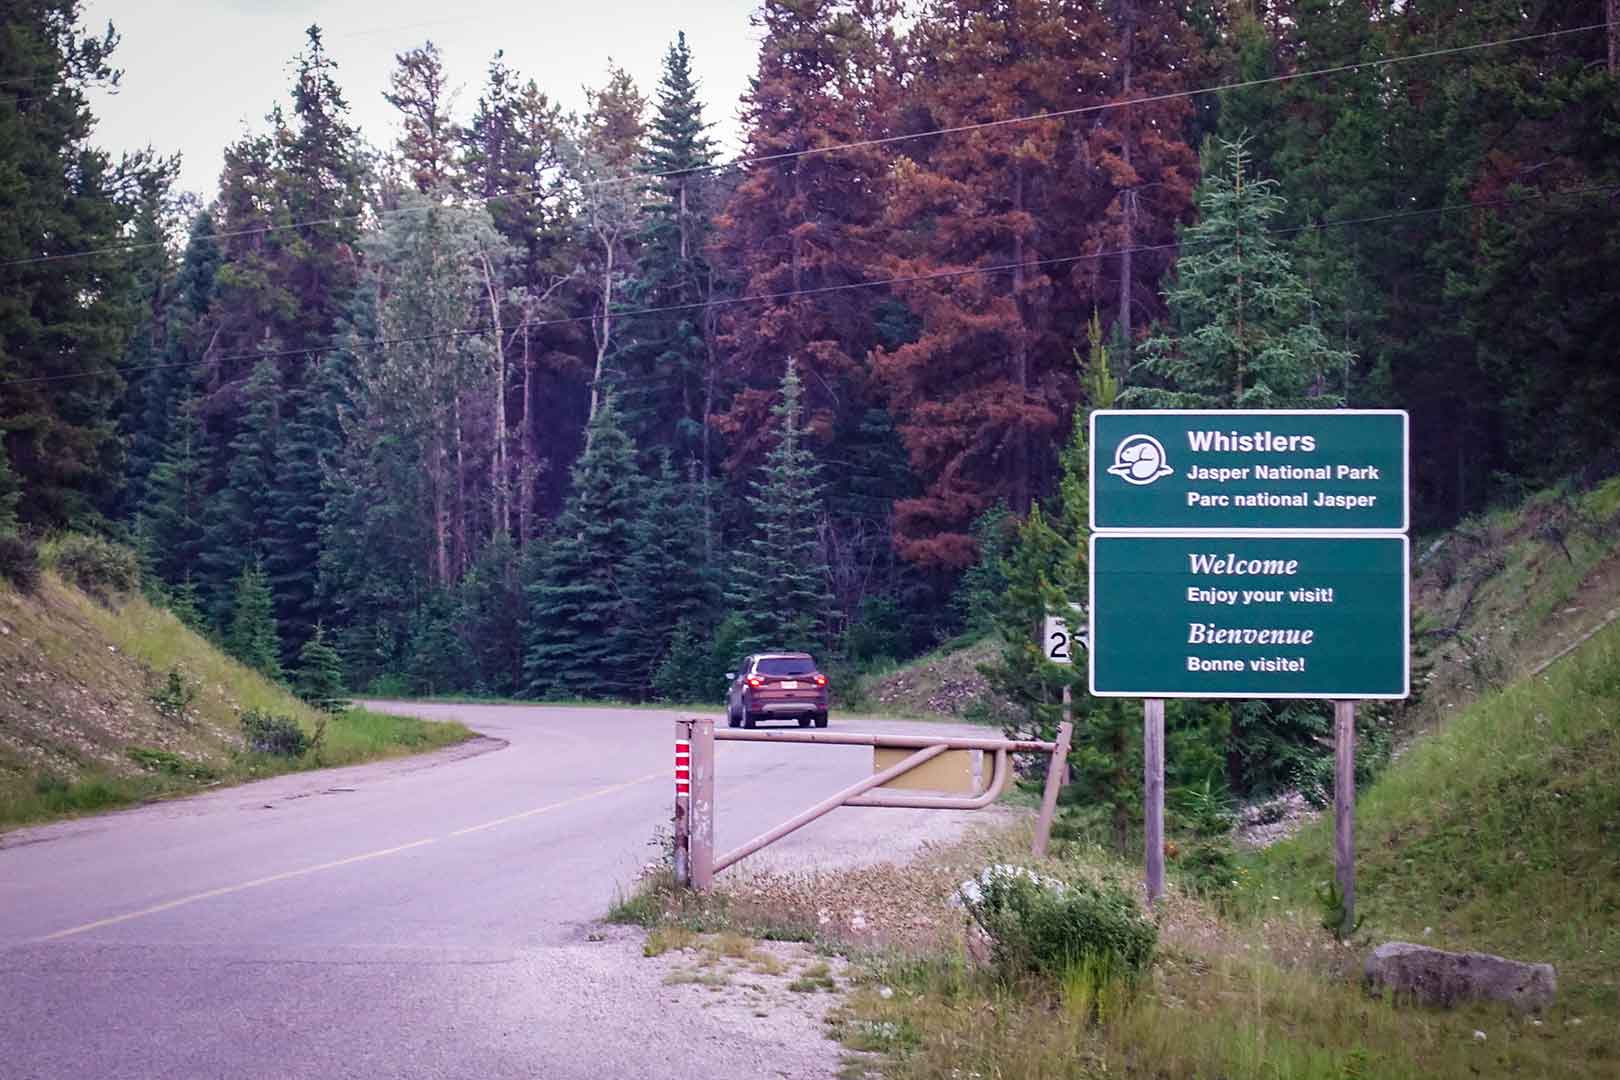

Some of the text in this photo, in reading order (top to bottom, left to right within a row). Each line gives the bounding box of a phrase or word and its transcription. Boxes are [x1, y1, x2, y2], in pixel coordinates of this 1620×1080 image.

[1187, 430, 1316, 452] Whistlers
[1186, 464, 1380, 482] Jasper National Park
[1187, 491, 1377, 510] Parc national Jasper
[1188, 553, 1298, 575] Welcome
[1187, 586, 1334, 605] Enjoy your visit!
[1187, 623, 1314, 645] Bienvenue
[1187, 656, 1306, 672] Bonne visite!
